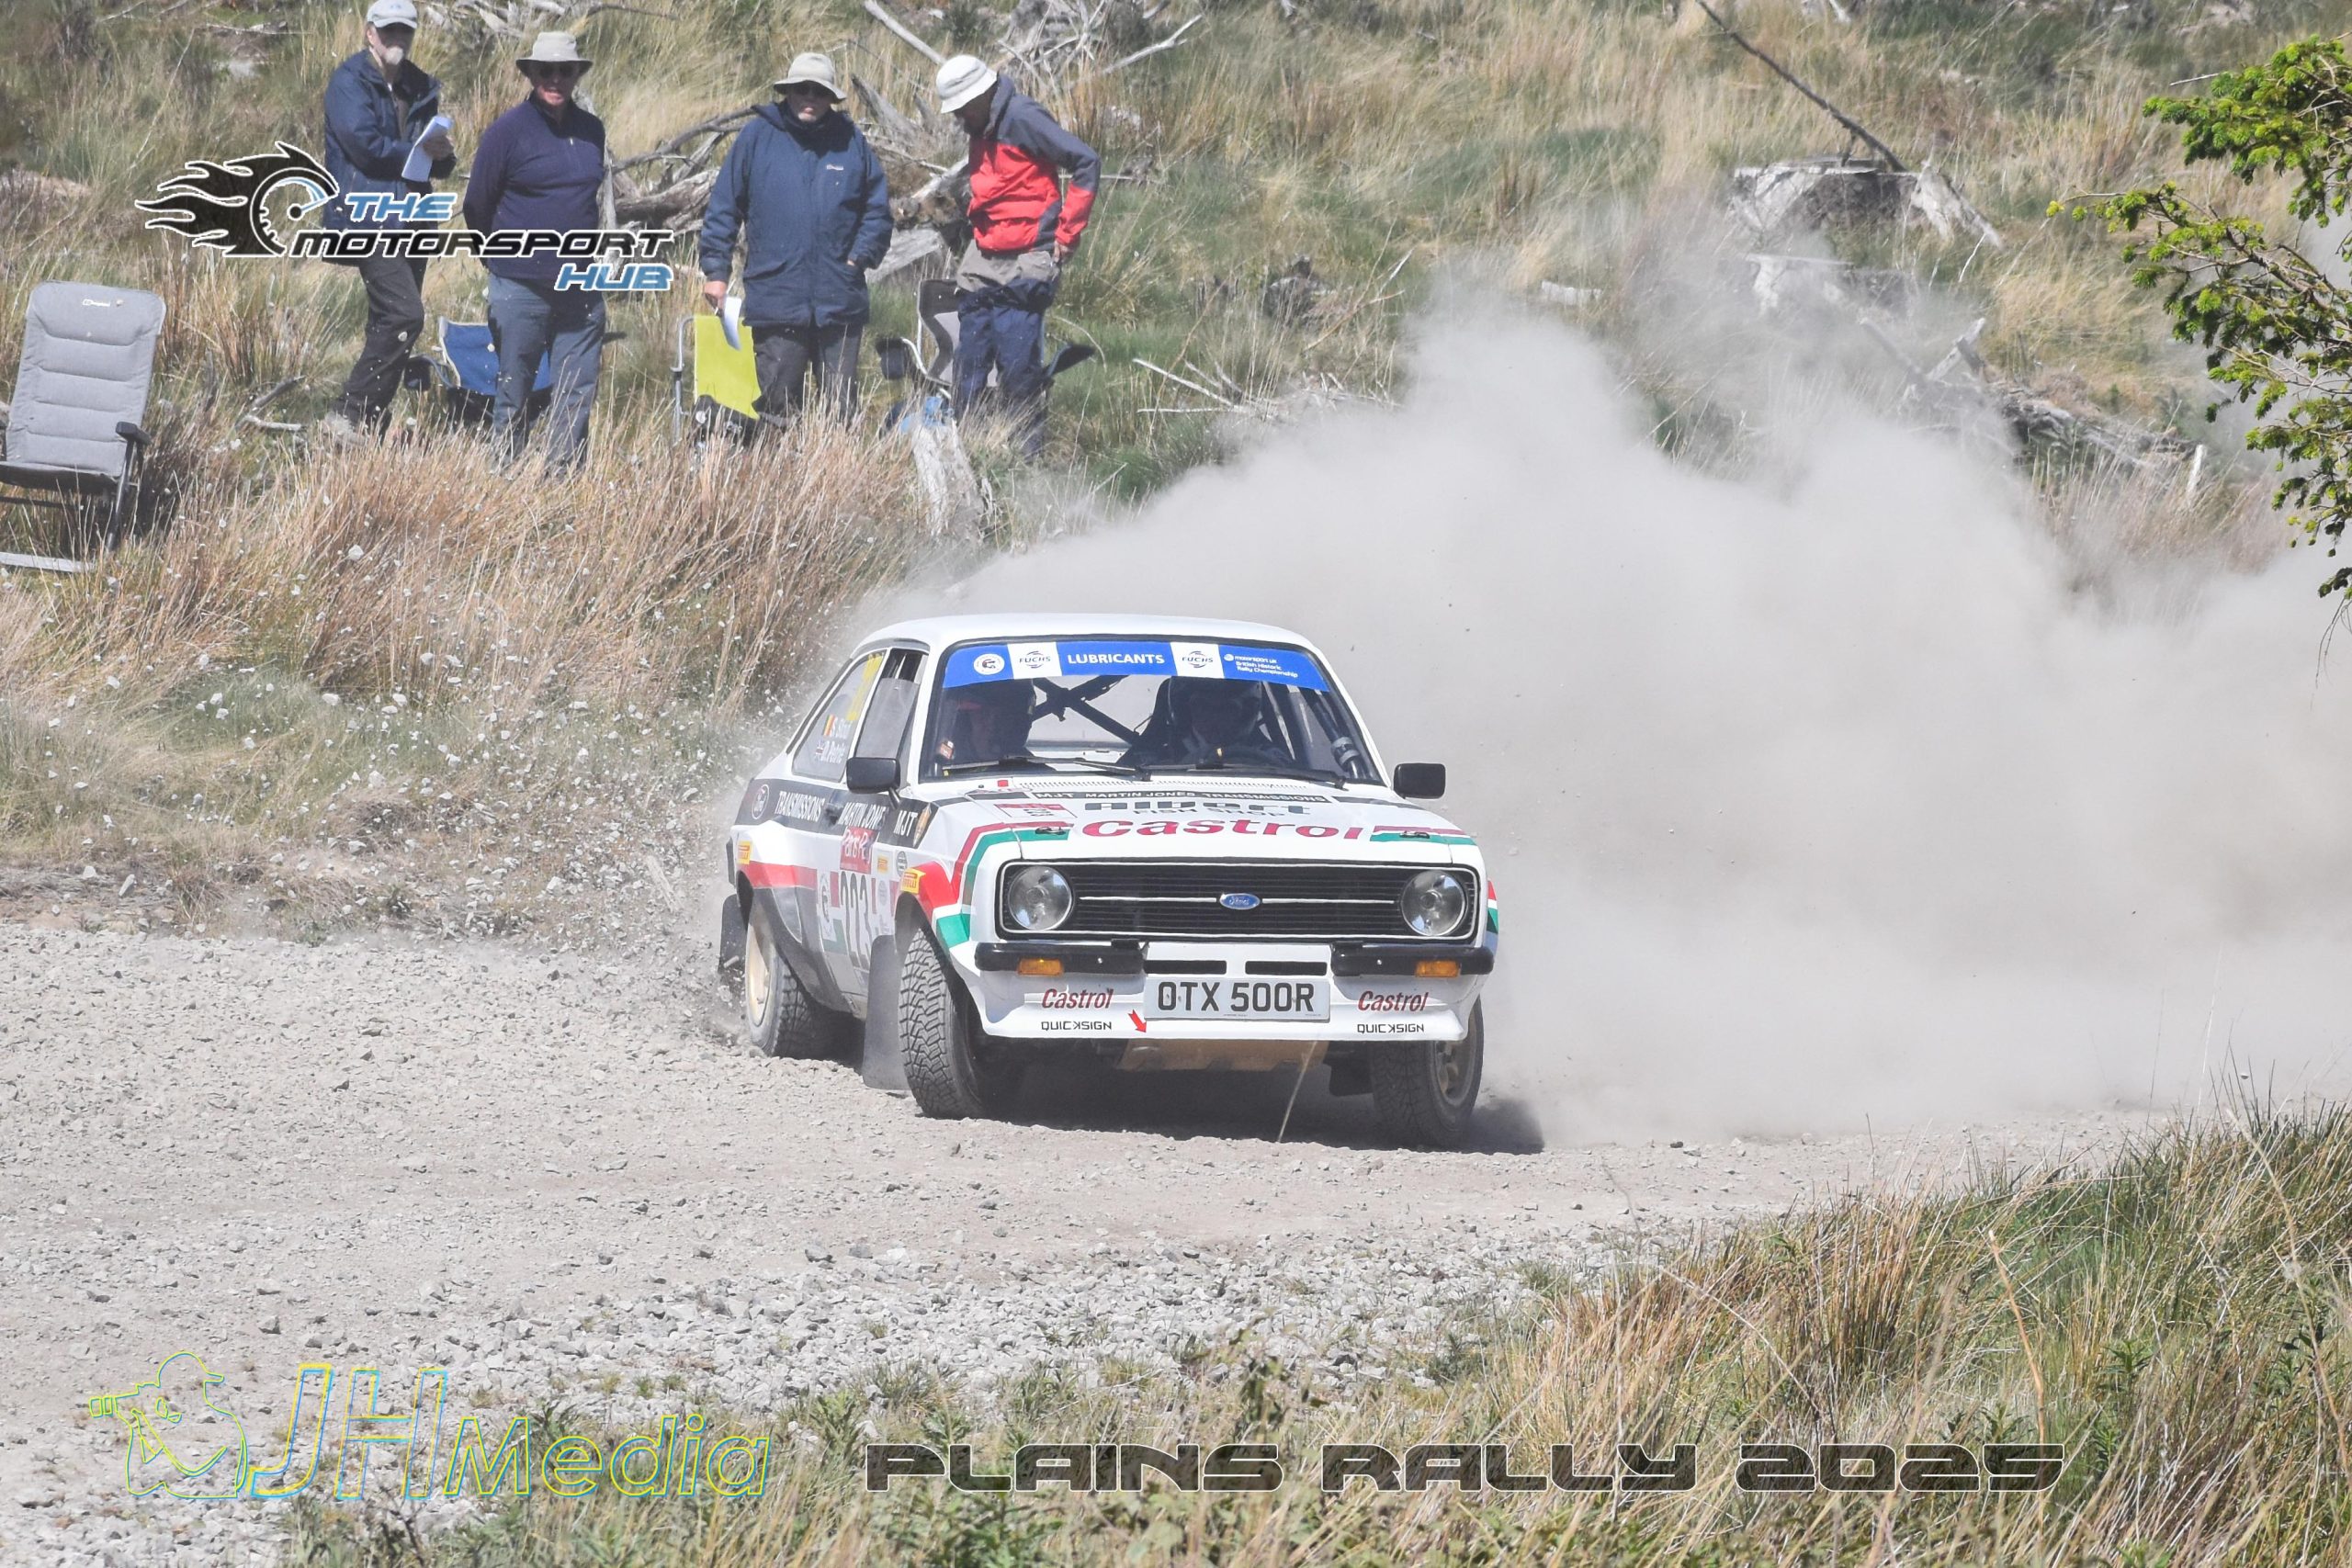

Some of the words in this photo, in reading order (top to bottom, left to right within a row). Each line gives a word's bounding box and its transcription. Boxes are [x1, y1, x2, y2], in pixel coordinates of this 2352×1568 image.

[1068, 653, 1165, 664] LUBRICANTS
[1203, 793, 1325, 802] TRANSMISSIONS
[893, 810, 919, 837] MJT
[1082, 818, 1363, 840] Castrol
[1041, 987, 1114, 1010] Castrol
[1158, 981, 1220, 1011] OTX
[1230, 982, 1315, 1012] 500R
[1357, 990, 1429, 1011] Castrol
[1041, 1021, 1112, 1032] QUICKSIGN
[1357, 1023, 1424, 1034] QUICKSIGN
